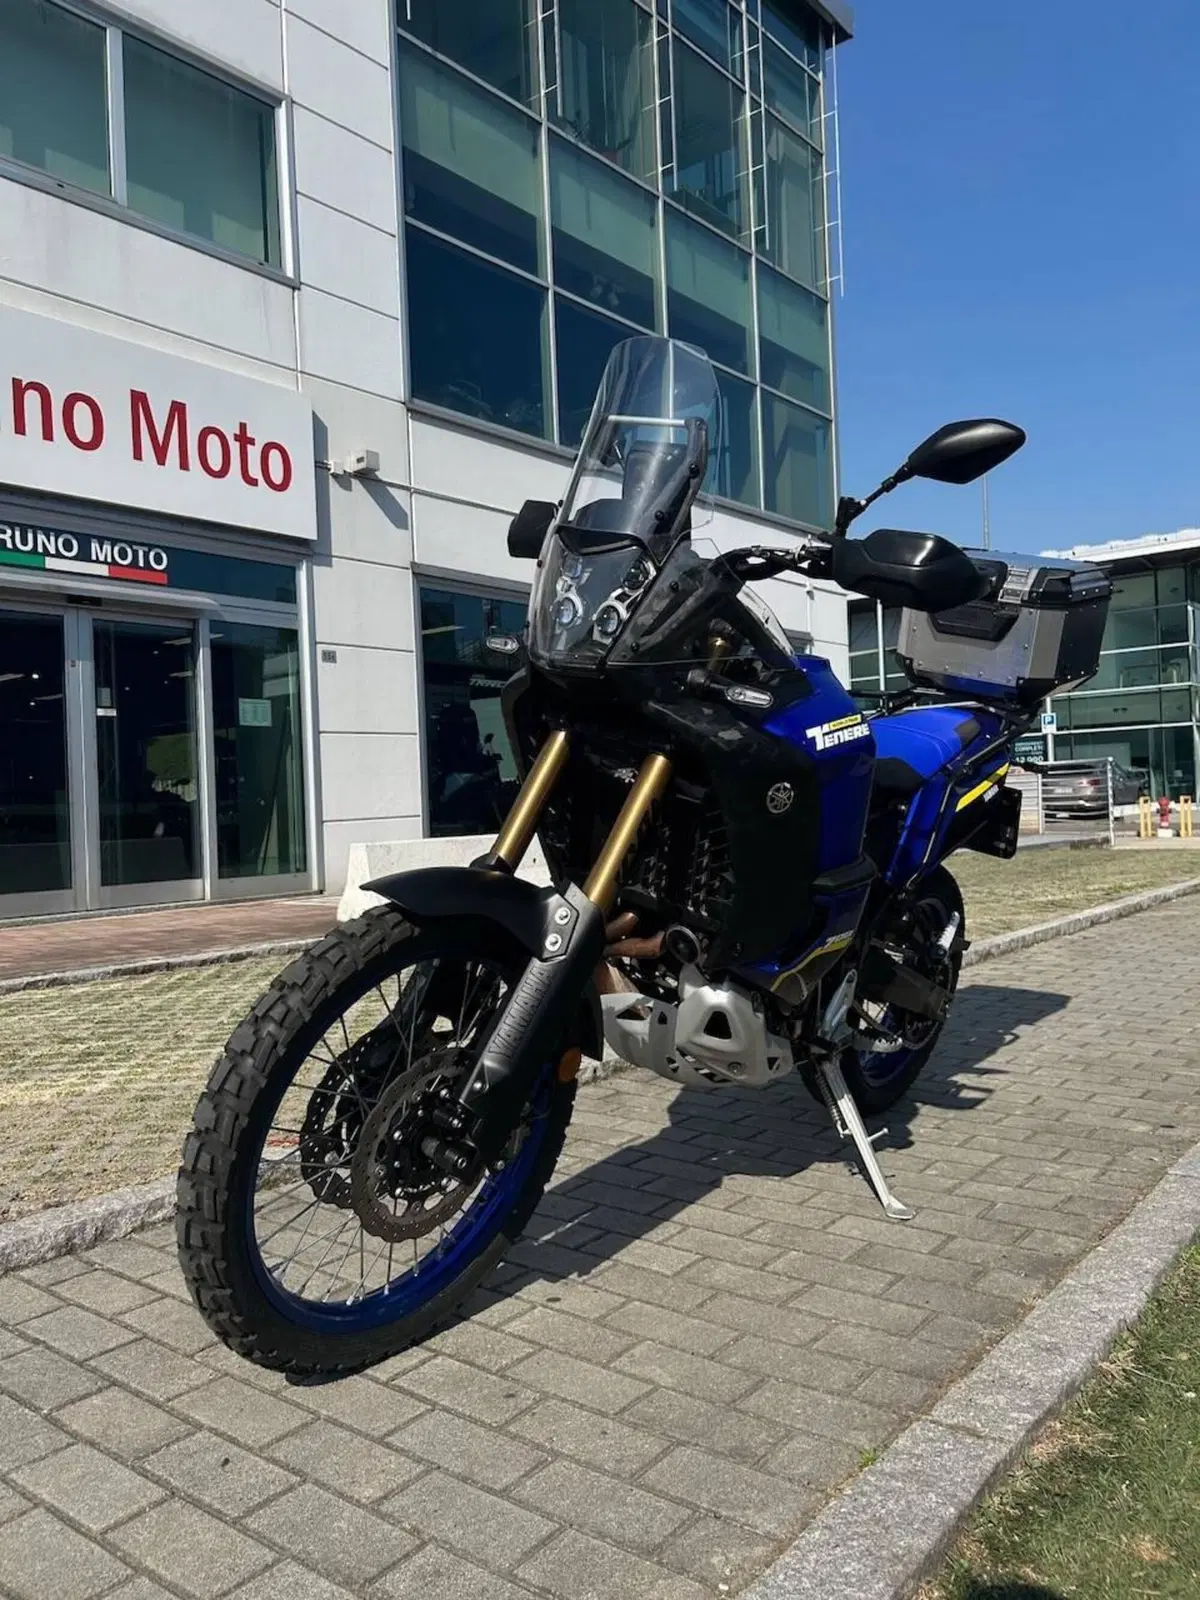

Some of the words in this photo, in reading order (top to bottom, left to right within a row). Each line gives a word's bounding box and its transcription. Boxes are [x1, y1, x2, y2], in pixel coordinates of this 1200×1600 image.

[12, 376, 105, 452] no
[129, 388, 293, 493] Moto
[0, 524, 79, 558] RUNO
[90, 538, 168, 571] MOTO
[488, 965, 552, 1058] YAMAHA
